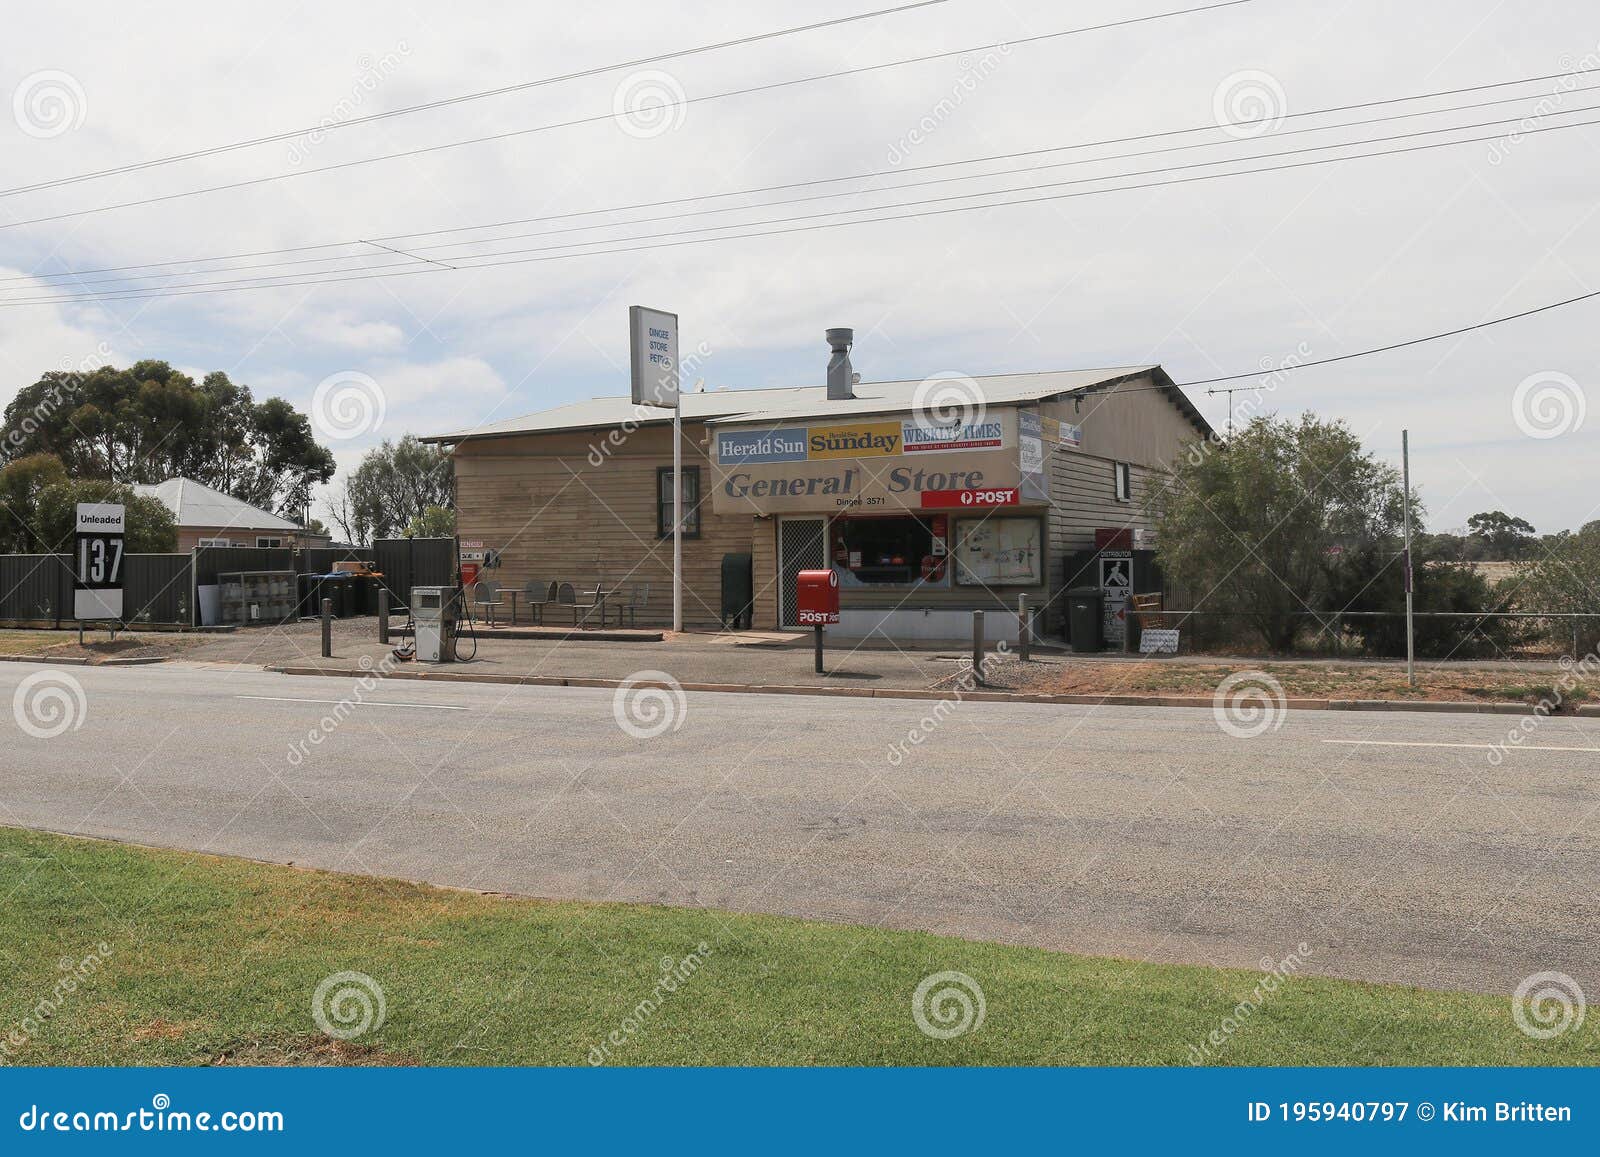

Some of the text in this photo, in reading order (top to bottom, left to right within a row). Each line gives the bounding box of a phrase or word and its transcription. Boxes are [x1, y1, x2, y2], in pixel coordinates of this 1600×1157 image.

[649, 341, 668, 352] STORE
[963, 422, 1001, 440] TIMES
[720, 437, 804, 457] Herald Sun
[810, 432, 899, 453] Sunday
[725, 467, 984, 498] General Store
[866, 497, 885, 505] 3571
[975, 490, 1014, 504] POST
[80, 514, 121, 525] Unleaded
[81, 538, 123, 583] 137
[799, 612, 829, 622] POST
